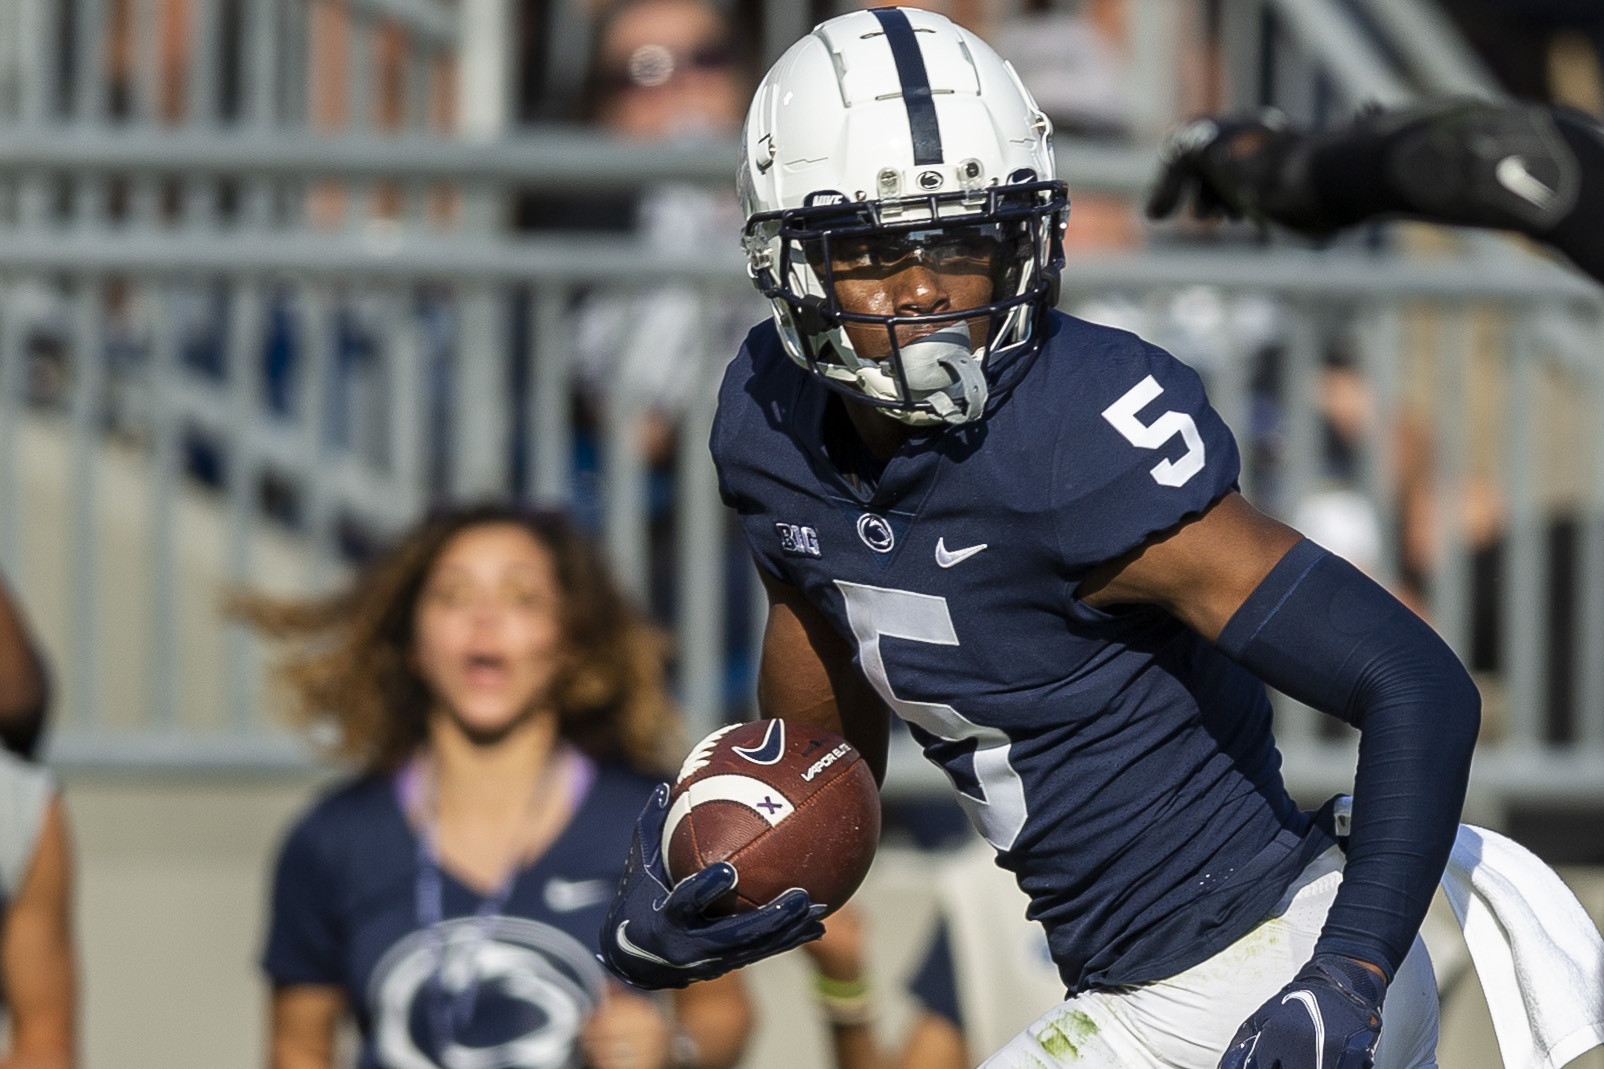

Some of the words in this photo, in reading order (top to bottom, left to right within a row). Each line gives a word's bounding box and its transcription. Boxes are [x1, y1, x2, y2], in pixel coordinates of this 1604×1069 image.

[1101, 374, 1205, 488] 5
[801, 753, 836, 781] VAPOR
[833, 580, 1028, 852] 5
